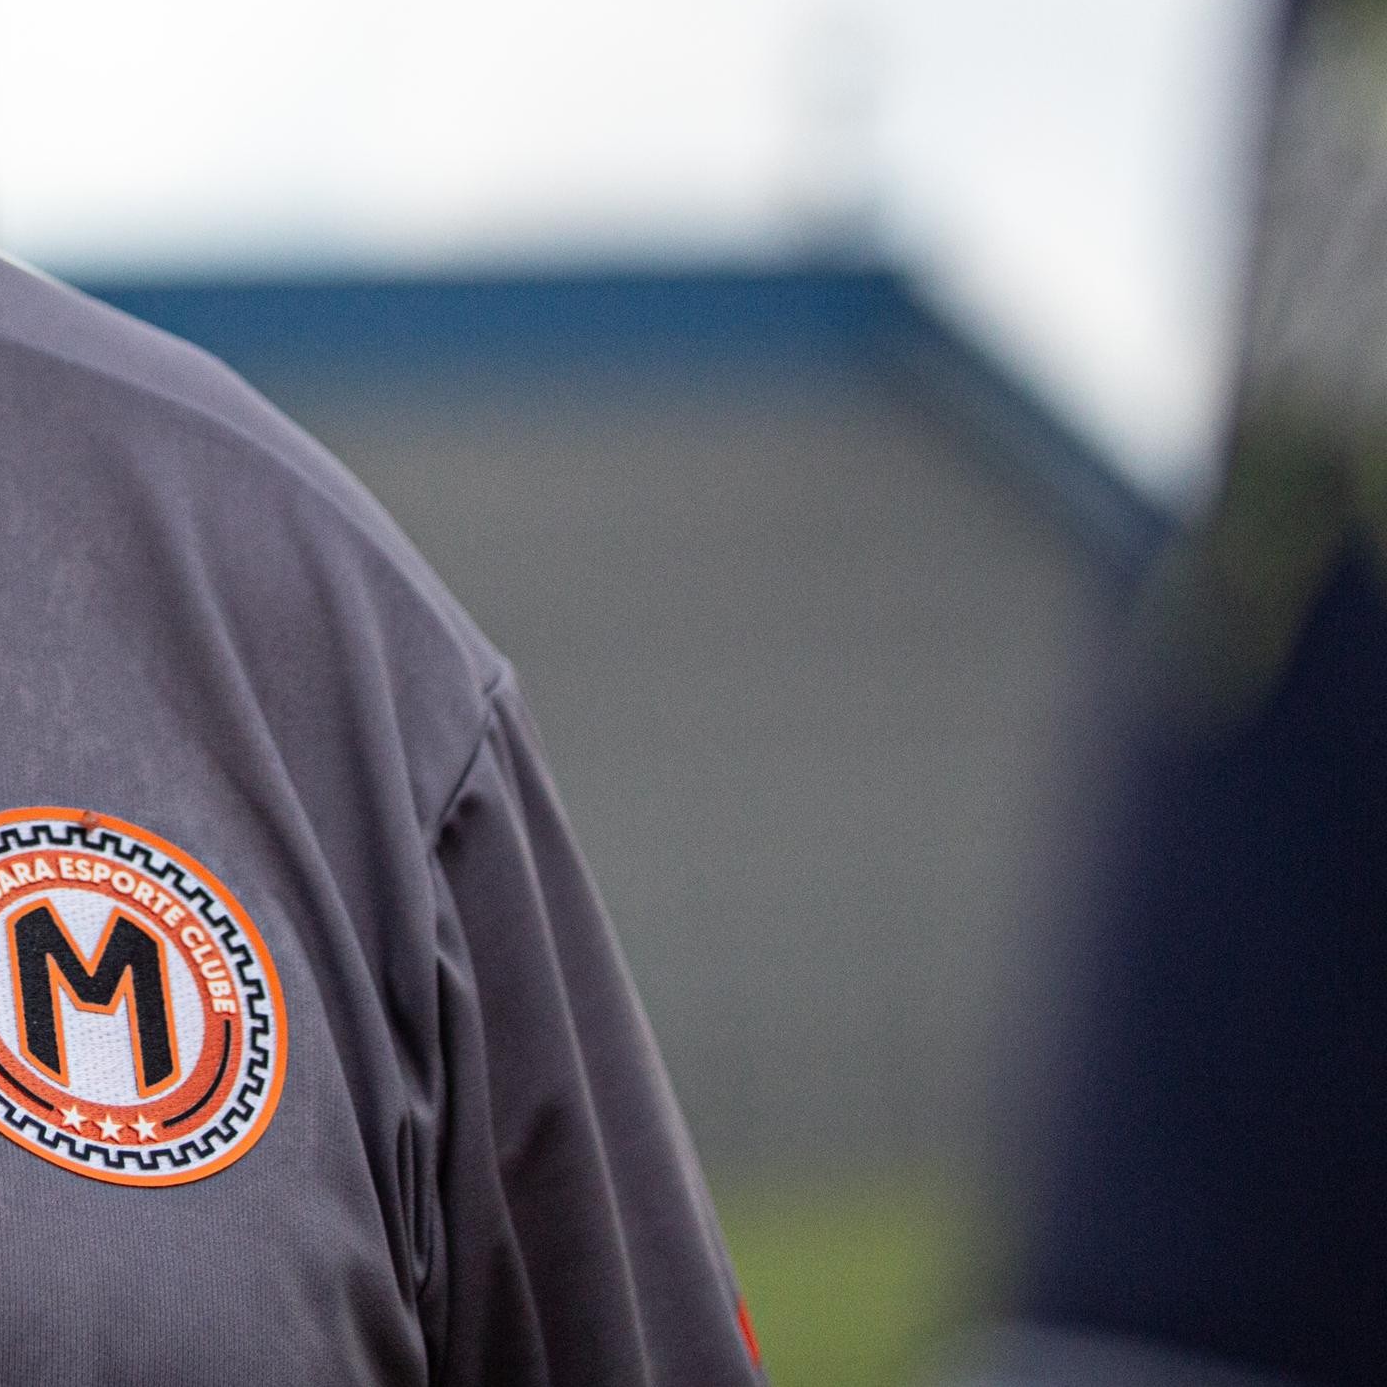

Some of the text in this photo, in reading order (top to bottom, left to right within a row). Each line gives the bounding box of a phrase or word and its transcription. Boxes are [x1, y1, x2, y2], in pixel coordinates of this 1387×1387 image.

[7, 897, 181, 1099] M
[58, 856, 184, 926] ESPORTE
[180, 924, 237, 1015] CLUBE
